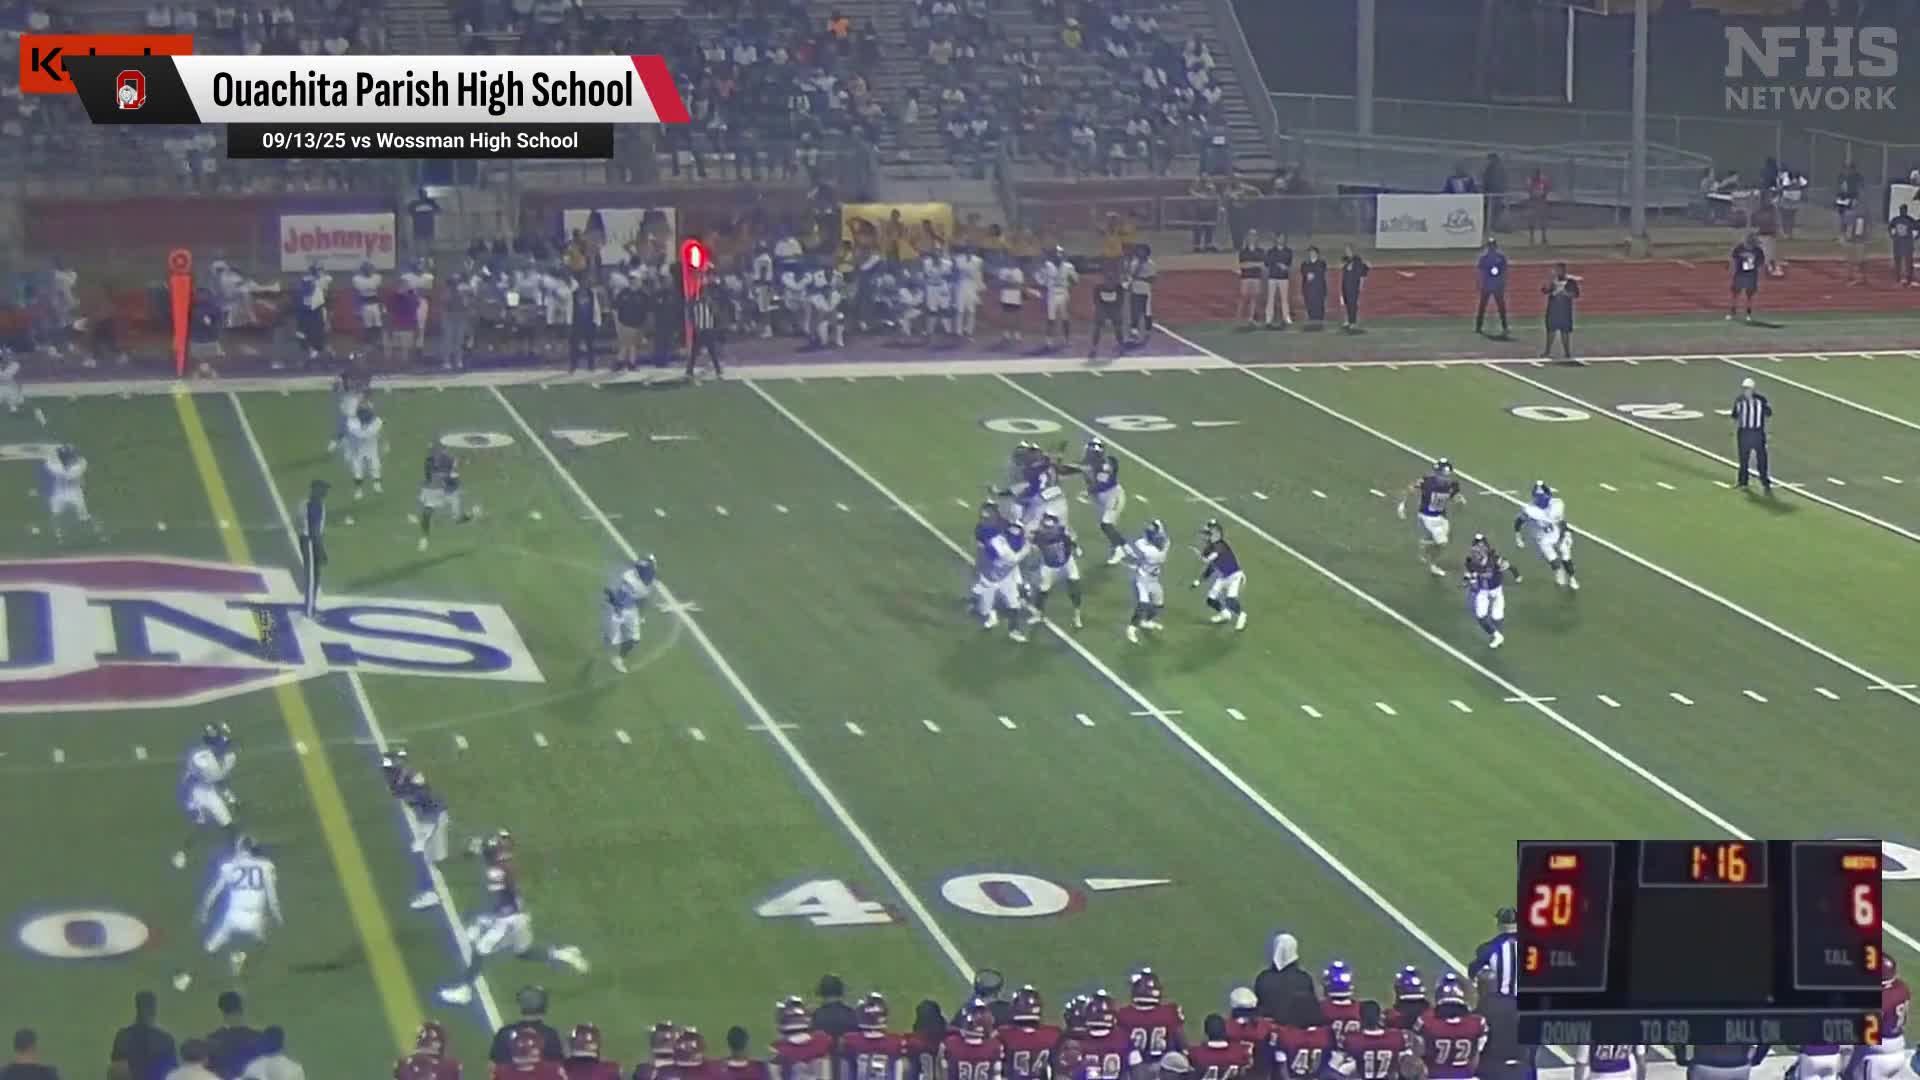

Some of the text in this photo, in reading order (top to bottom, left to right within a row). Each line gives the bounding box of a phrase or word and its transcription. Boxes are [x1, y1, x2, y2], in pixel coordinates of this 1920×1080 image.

[284, 225, 393, 257] Johnny's
[232, 867, 264, 889] 20
[1435, 1039, 1472, 1066] 72
